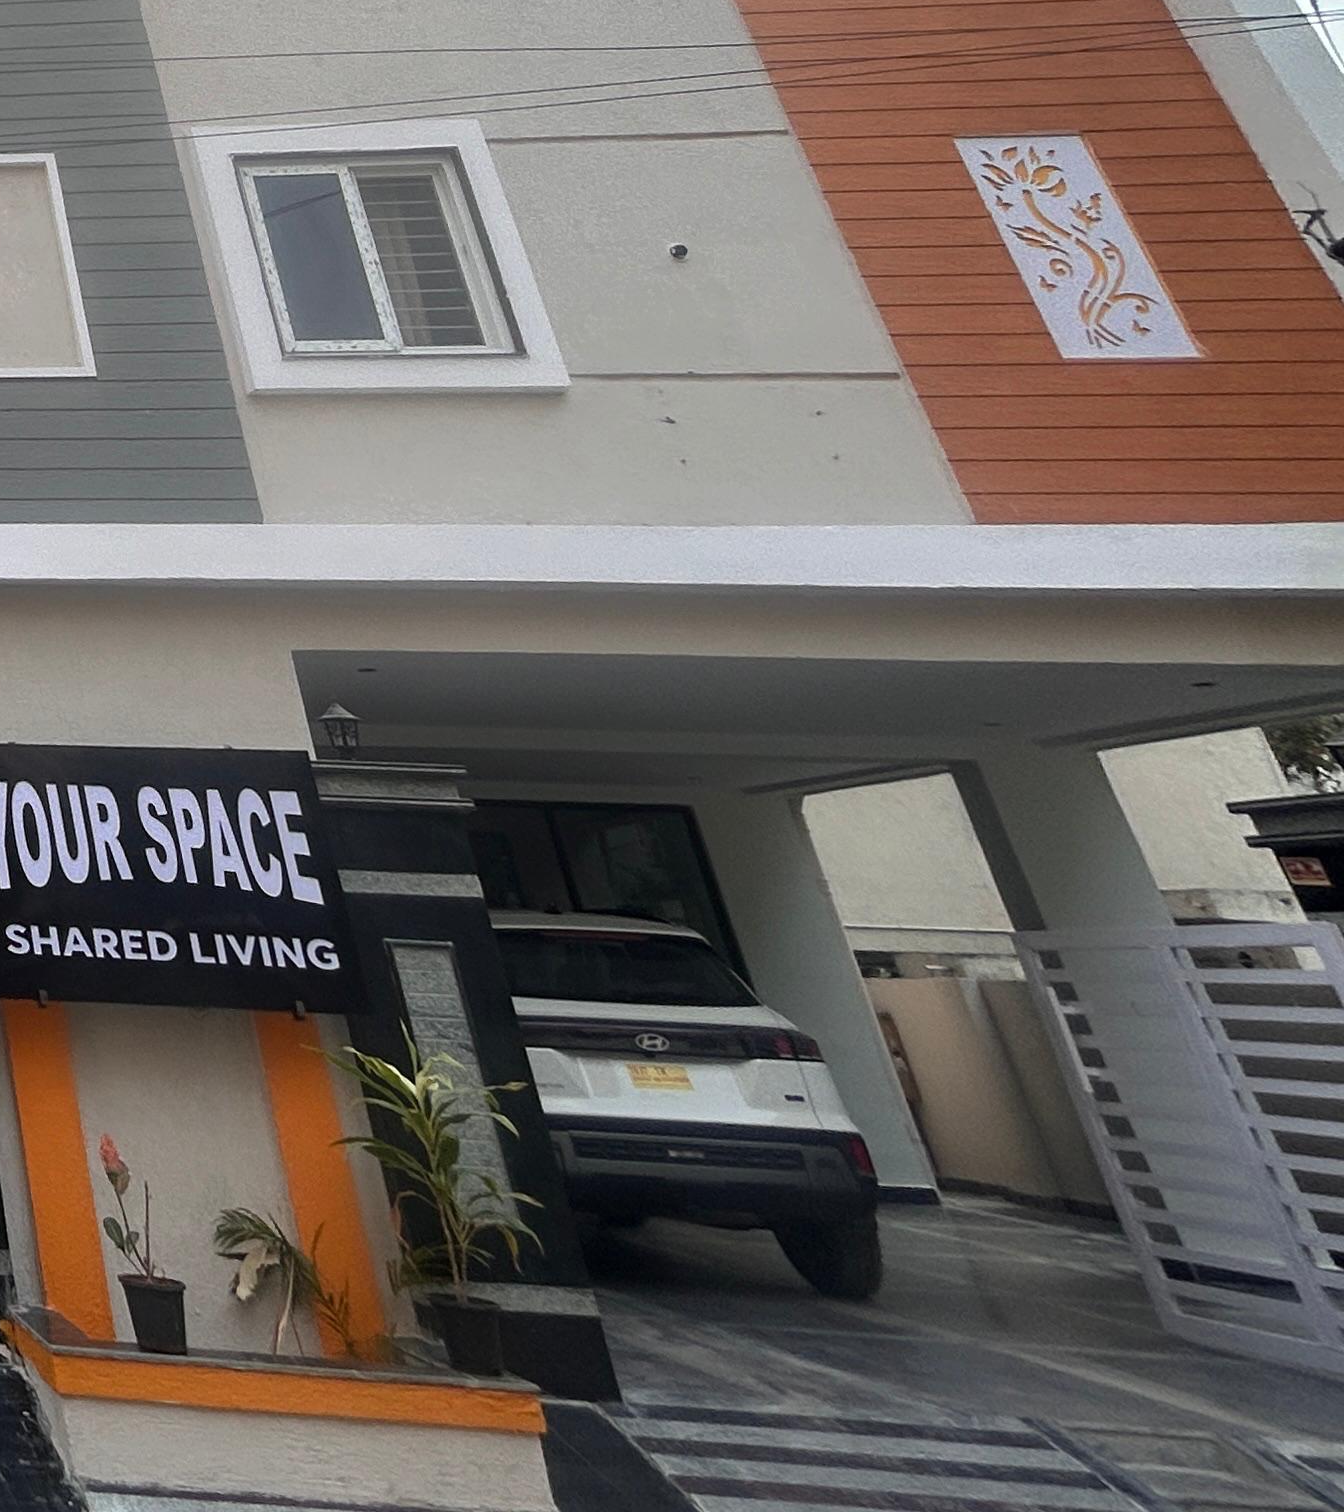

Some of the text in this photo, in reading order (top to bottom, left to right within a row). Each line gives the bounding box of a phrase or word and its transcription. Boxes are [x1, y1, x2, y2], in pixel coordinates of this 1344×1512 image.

[137, 785, 325, 906] SPACE
[5, 924, 340, 971] SHARED LIVING
